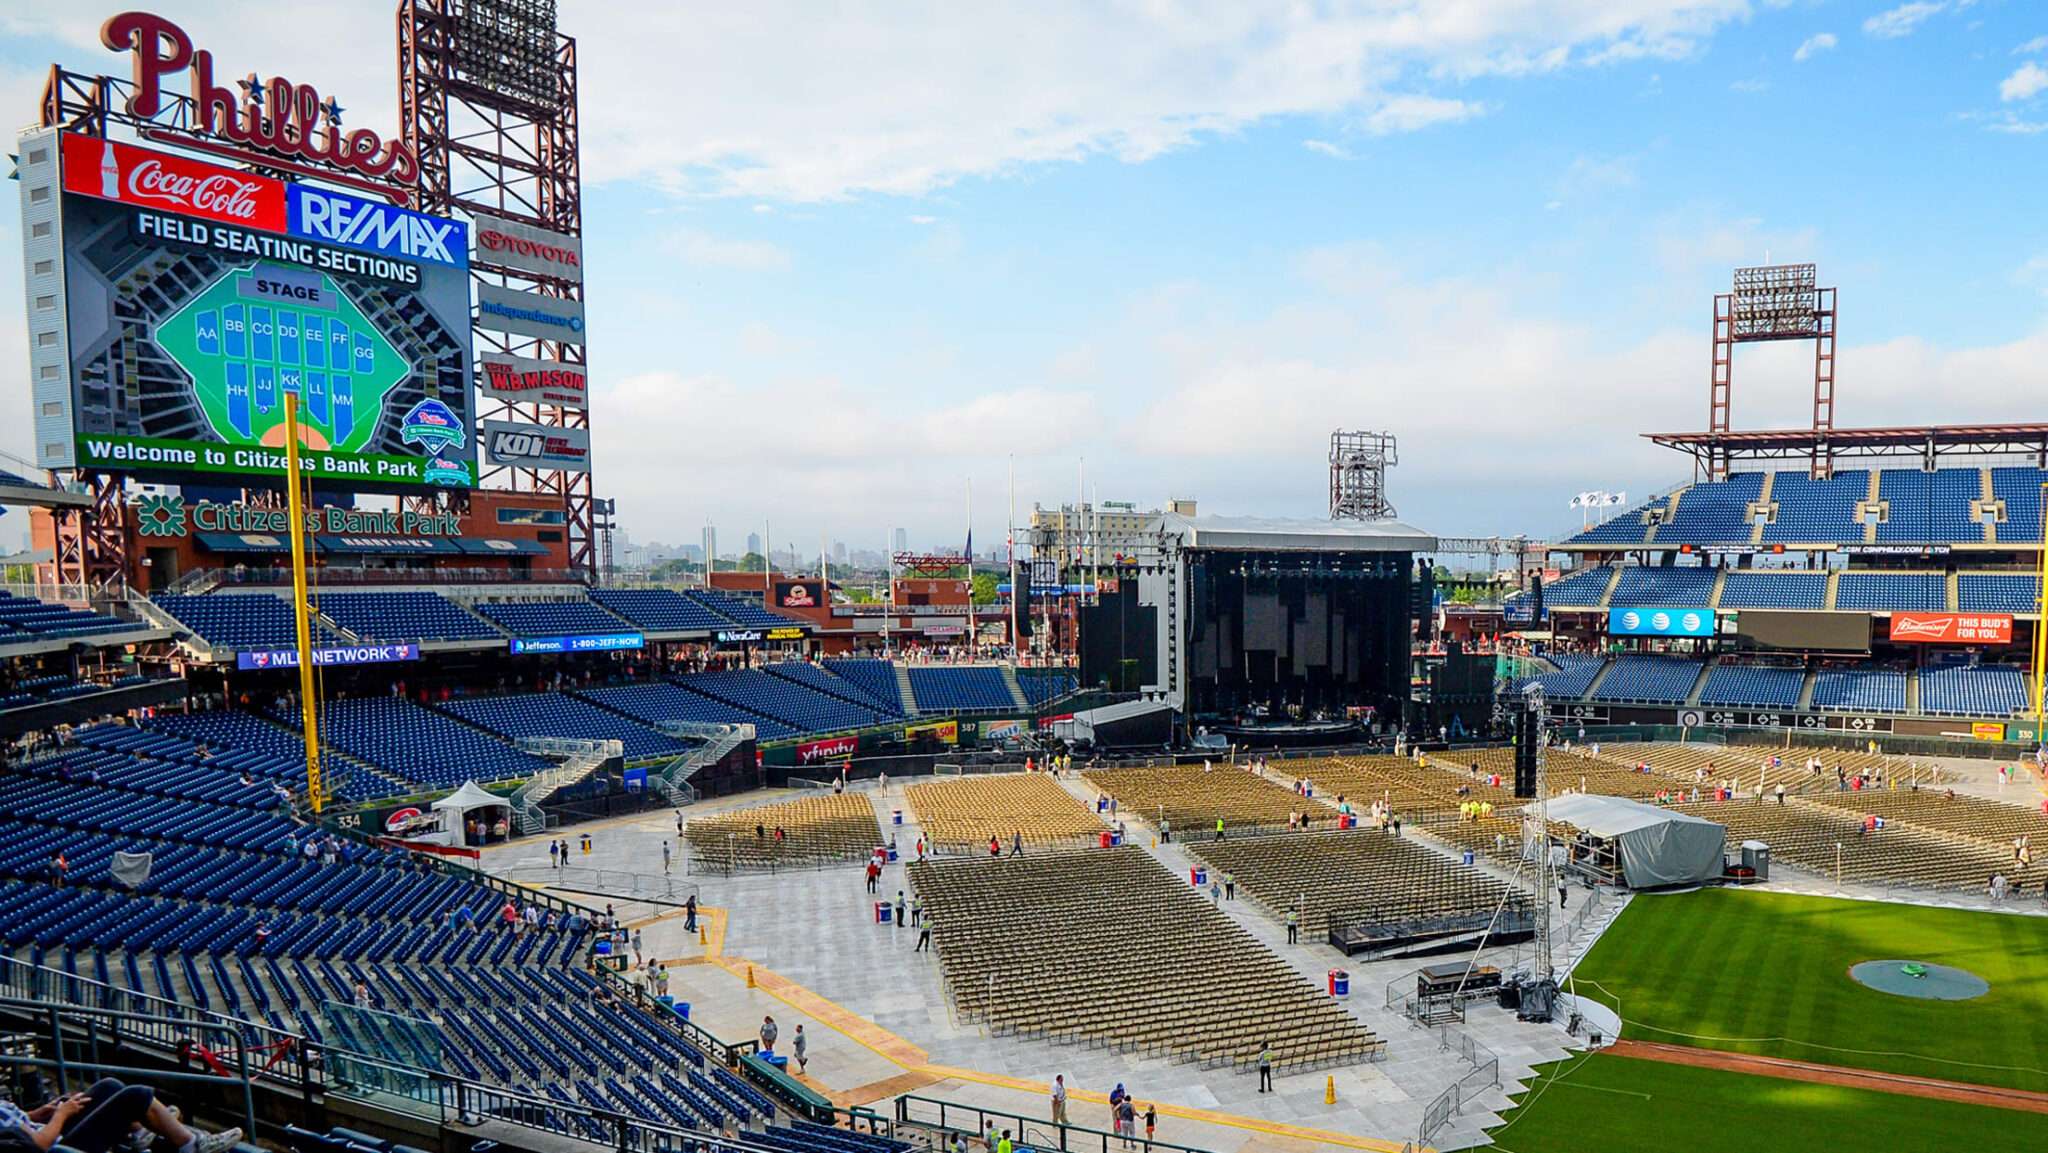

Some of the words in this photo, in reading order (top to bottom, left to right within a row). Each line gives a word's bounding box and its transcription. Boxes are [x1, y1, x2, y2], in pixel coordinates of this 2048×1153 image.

[101, 11, 420, 184] Phillies
[128, 160, 263, 219] Coca-Cola
[301, 191, 455, 263] RE/MAX
[139, 213, 208, 244] FIELD
[214, 228, 313, 264] SEATING
[318, 249, 417, 283] SECTIONS
[505, 235, 579, 267] TOYOTA
[257, 280, 319, 301] STAGE
[225, 320, 244, 332] BB
[252, 323, 272, 335] CC
[279, 325, 298, 338] DD
[197, 328, 217, 340] AA
[305, 329, 323, 341] EE
[332, 333, 348, 344] FF
[354, 347, 374, 359] GG
[257, 379, 272, 391] JJ
[282, 374, 300, 386] KK
[227, 384, 248, 397] HH
[309, 383, 324, 395] LL
[332, 394, 353, 406] MM
[88, 440, 196, 463] Welcome
[204, 449, 225, 465] to
[324, 457, 370, 474] Bank
[377, 460, 418, 477] Park
[193, 503, 321, 532] Citizes
[327, 507, 400, 534] Bank
[403, 511, 462, 536] Park
[1900, 621, 1946, 631] Budweiser
[1957, 618, 1979, 627] THIS
[1981, 618, 2009, 628] BUD'S
[726, 630, 761, 641] NovaCare
[1957, 628, 1975, 638] FOR
[1977, 629, 1999, 639] YOU.
[572, 637, 639, 648] 1-800-JEFF-NOW
[272, 652, 301, 665] ML
[311, 647, 390, 663] NETWORK
[961, 723, 976, 732] 387
[310, 757, 320, 801] 329
[338, 814, 361, 829] 334
